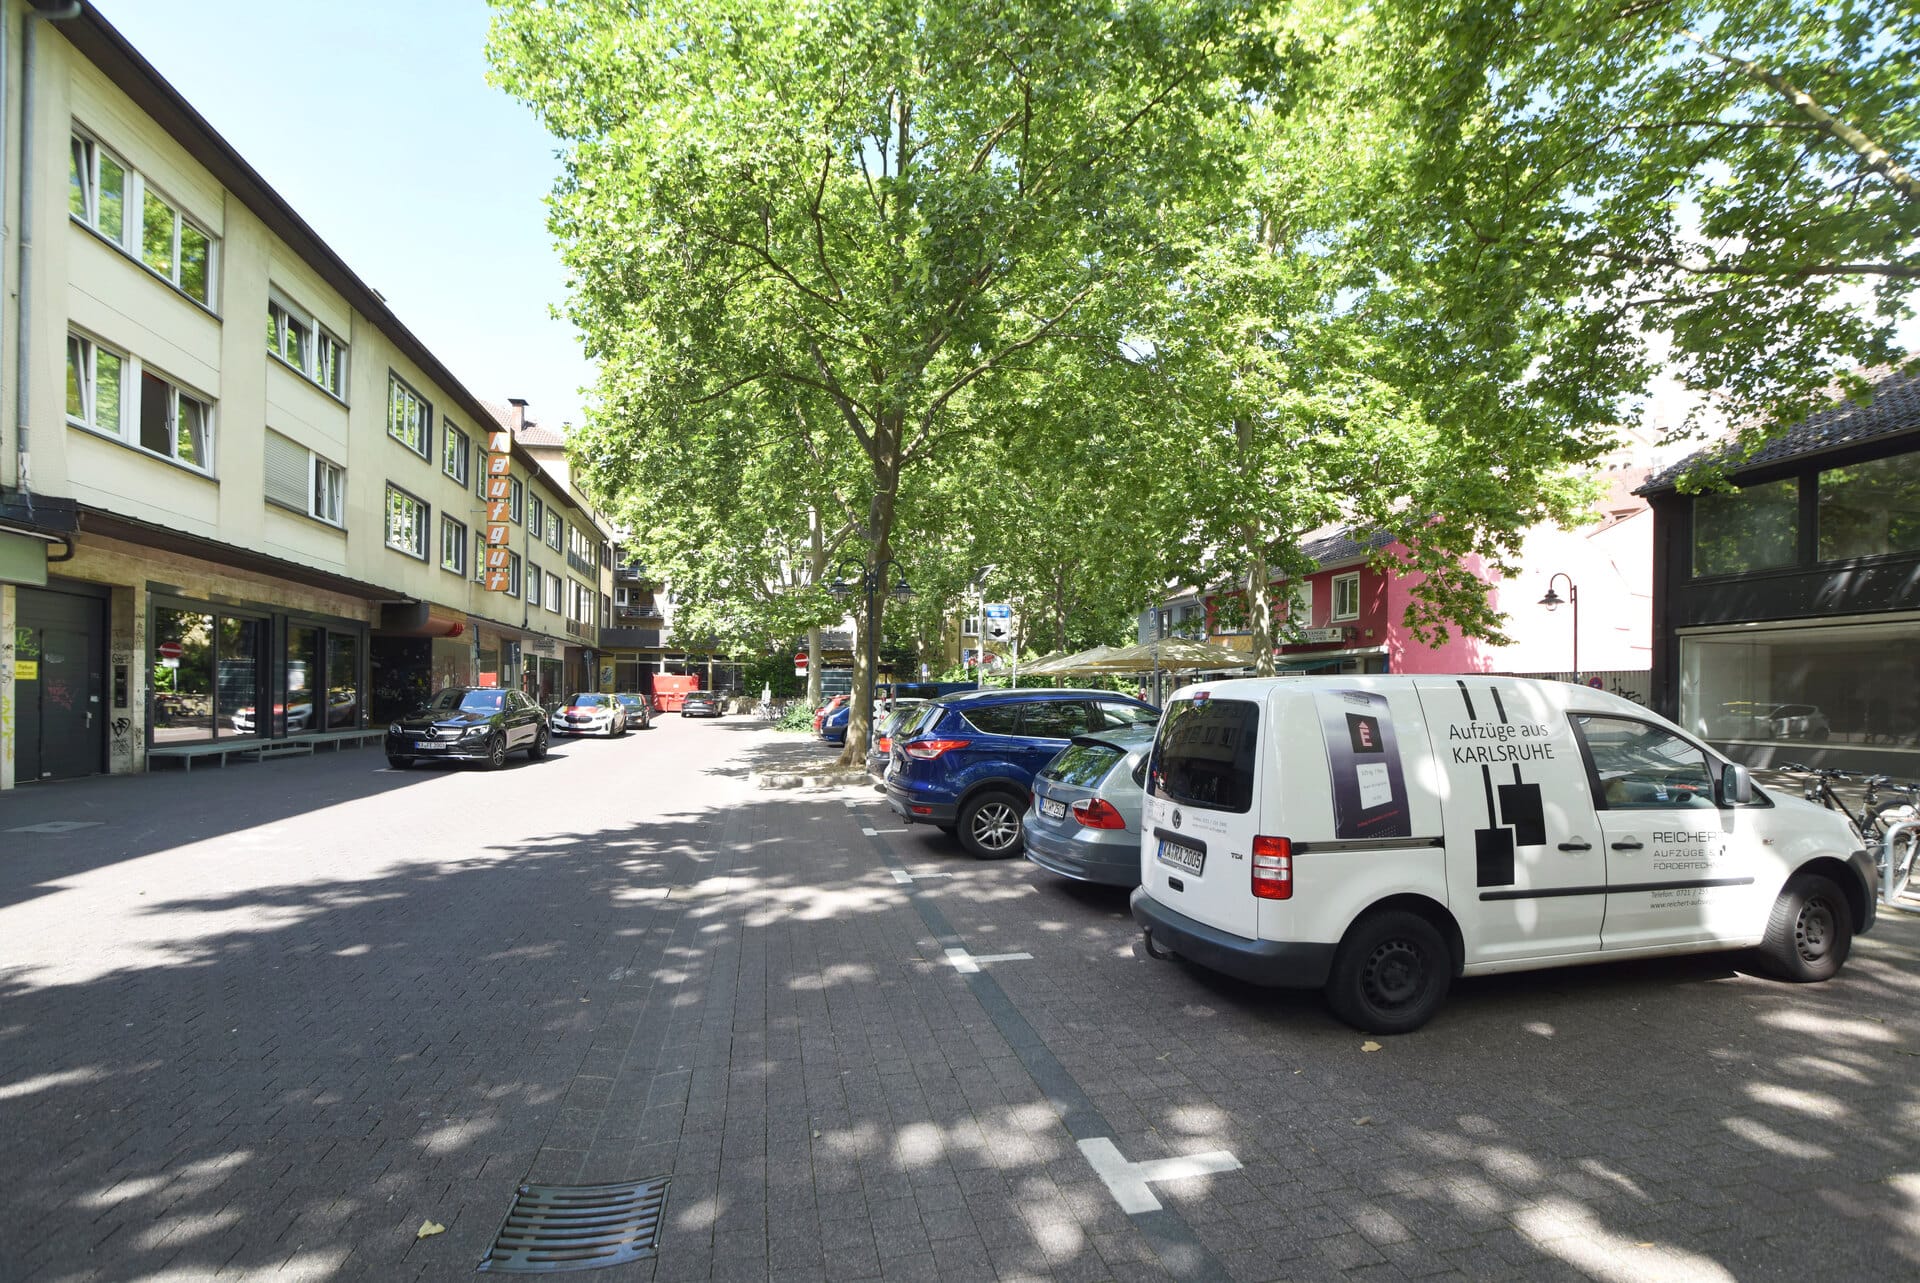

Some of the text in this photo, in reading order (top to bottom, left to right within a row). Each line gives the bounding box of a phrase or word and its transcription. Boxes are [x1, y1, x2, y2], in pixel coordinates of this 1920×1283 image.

[489, 432, 509, 590] Kaufgut
[1449, 722, 1549, 742] Aufzüge aus
[1452, 743, 1555, 764] KARLSRUHE
[1652, 831, 1722, 843] REICHER
[1183, 849, 1202, 869] 2005
[1652, 861, 1718, 870] FÖRDERTECH
